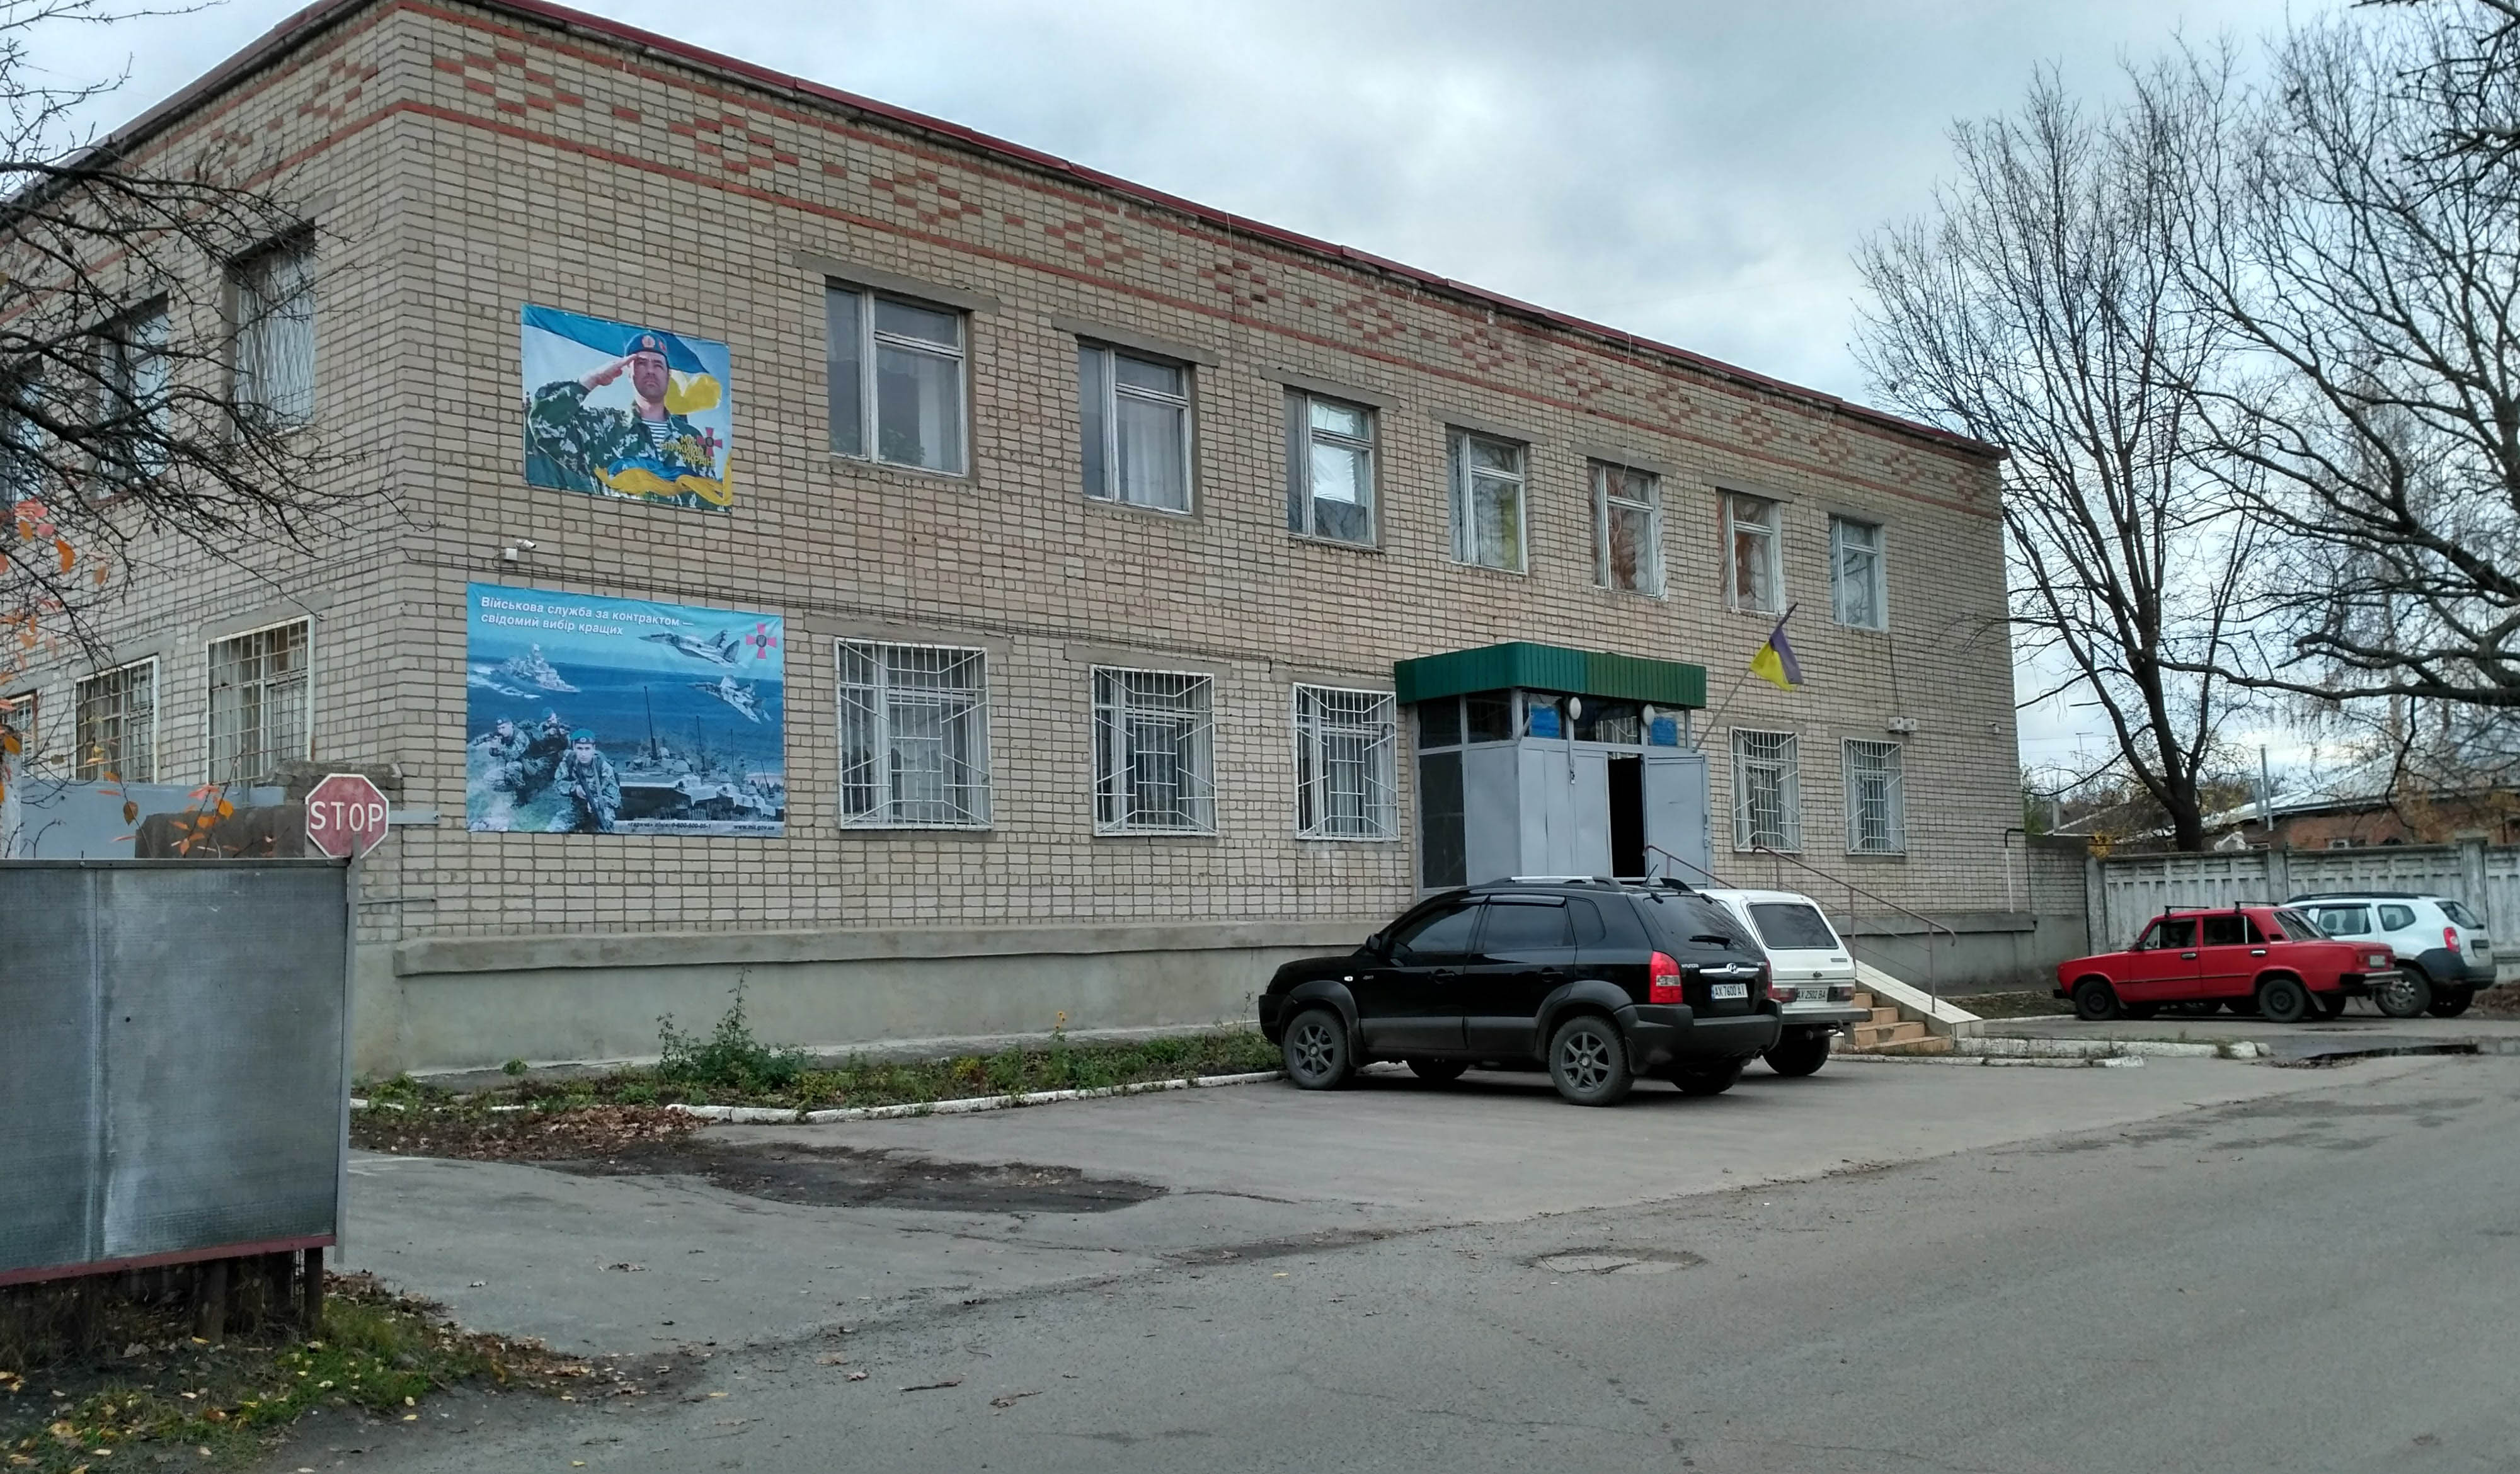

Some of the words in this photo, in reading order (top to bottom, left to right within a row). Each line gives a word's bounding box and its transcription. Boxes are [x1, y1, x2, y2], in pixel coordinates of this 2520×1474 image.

[481, 596, 544, 613] Військова
[547, 605, 592, 617] служба
[595, 610, 609, 619] за
[612, 612, 679, 626] контрактом
[481, 613, 539, 627] свідомий
[543, 619, 575, 632] вибір
[578, 623, 623, 636] кращих
[311, 801, 383, 832] STOP
